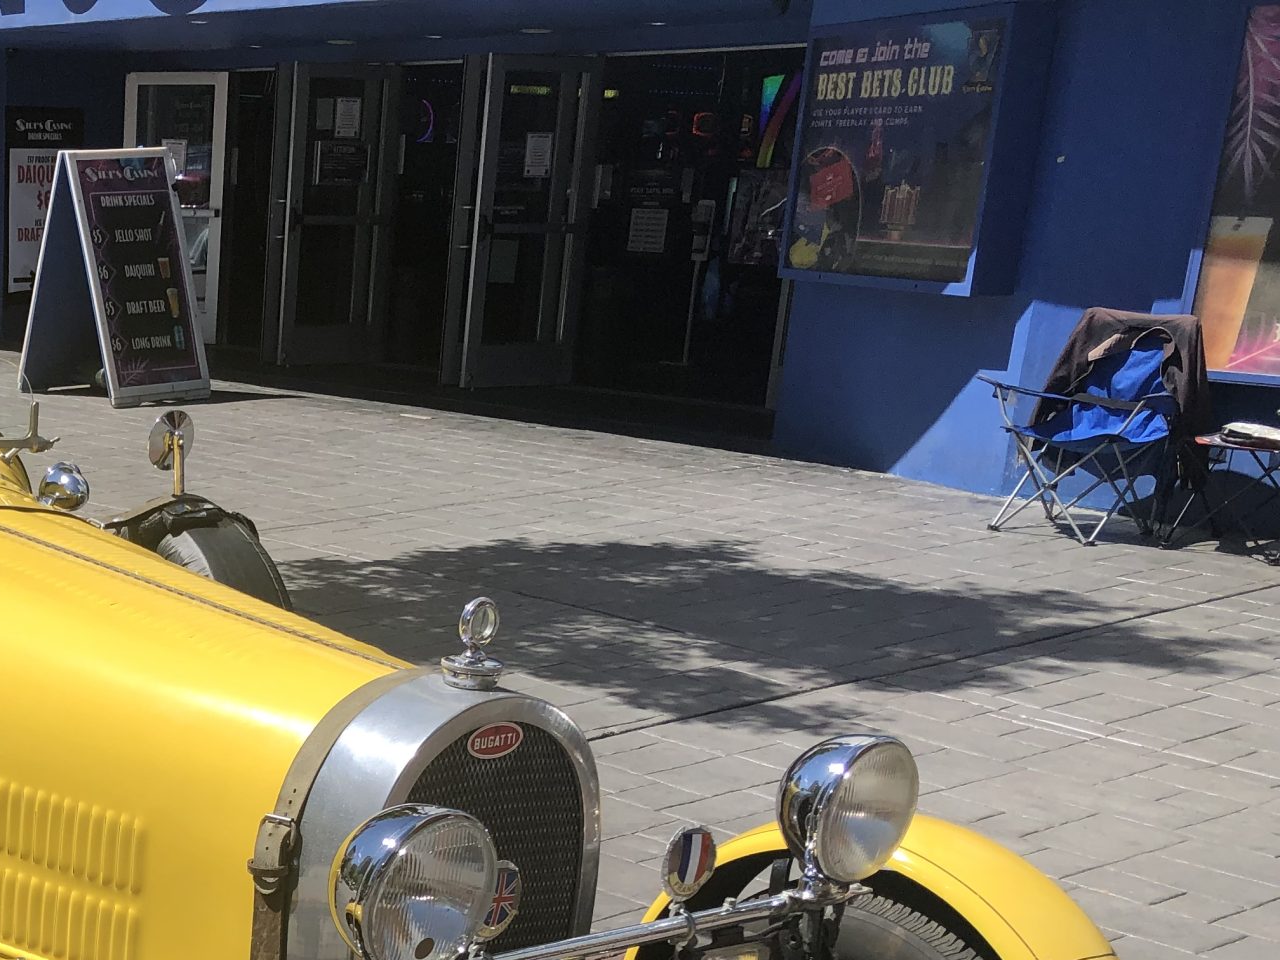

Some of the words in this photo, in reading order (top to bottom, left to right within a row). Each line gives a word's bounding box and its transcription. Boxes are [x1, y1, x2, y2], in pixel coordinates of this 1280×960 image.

[904, 38, 931, 60] the
[817, 71, 856, 100] BEST
[860, 68, 903, 98] BETS
[907, 65, 954, 97] CLUB
[101, 195, 123, 207] DRINK
[124, 194, 155, 206] SPECIALS
[93, 229, 102, 243] $5
[115, 229, 134, 243] JELLO
[134, 228, 153, 241] SHOT
[99, 265, 109, 280] $6
[124, 264, 155, 279] DAIQUIRI
[105, 302, 115, 316] $5
[126, 301, 148, 315] DRAFT
[149, 300, 166, 313] BEER
[112, 338, 122, 351] $6
[132, 337, 150, 350] LONG
[151, 336, 172, 349] DRINK
[473, 733, 517, 750] BUGATTI
